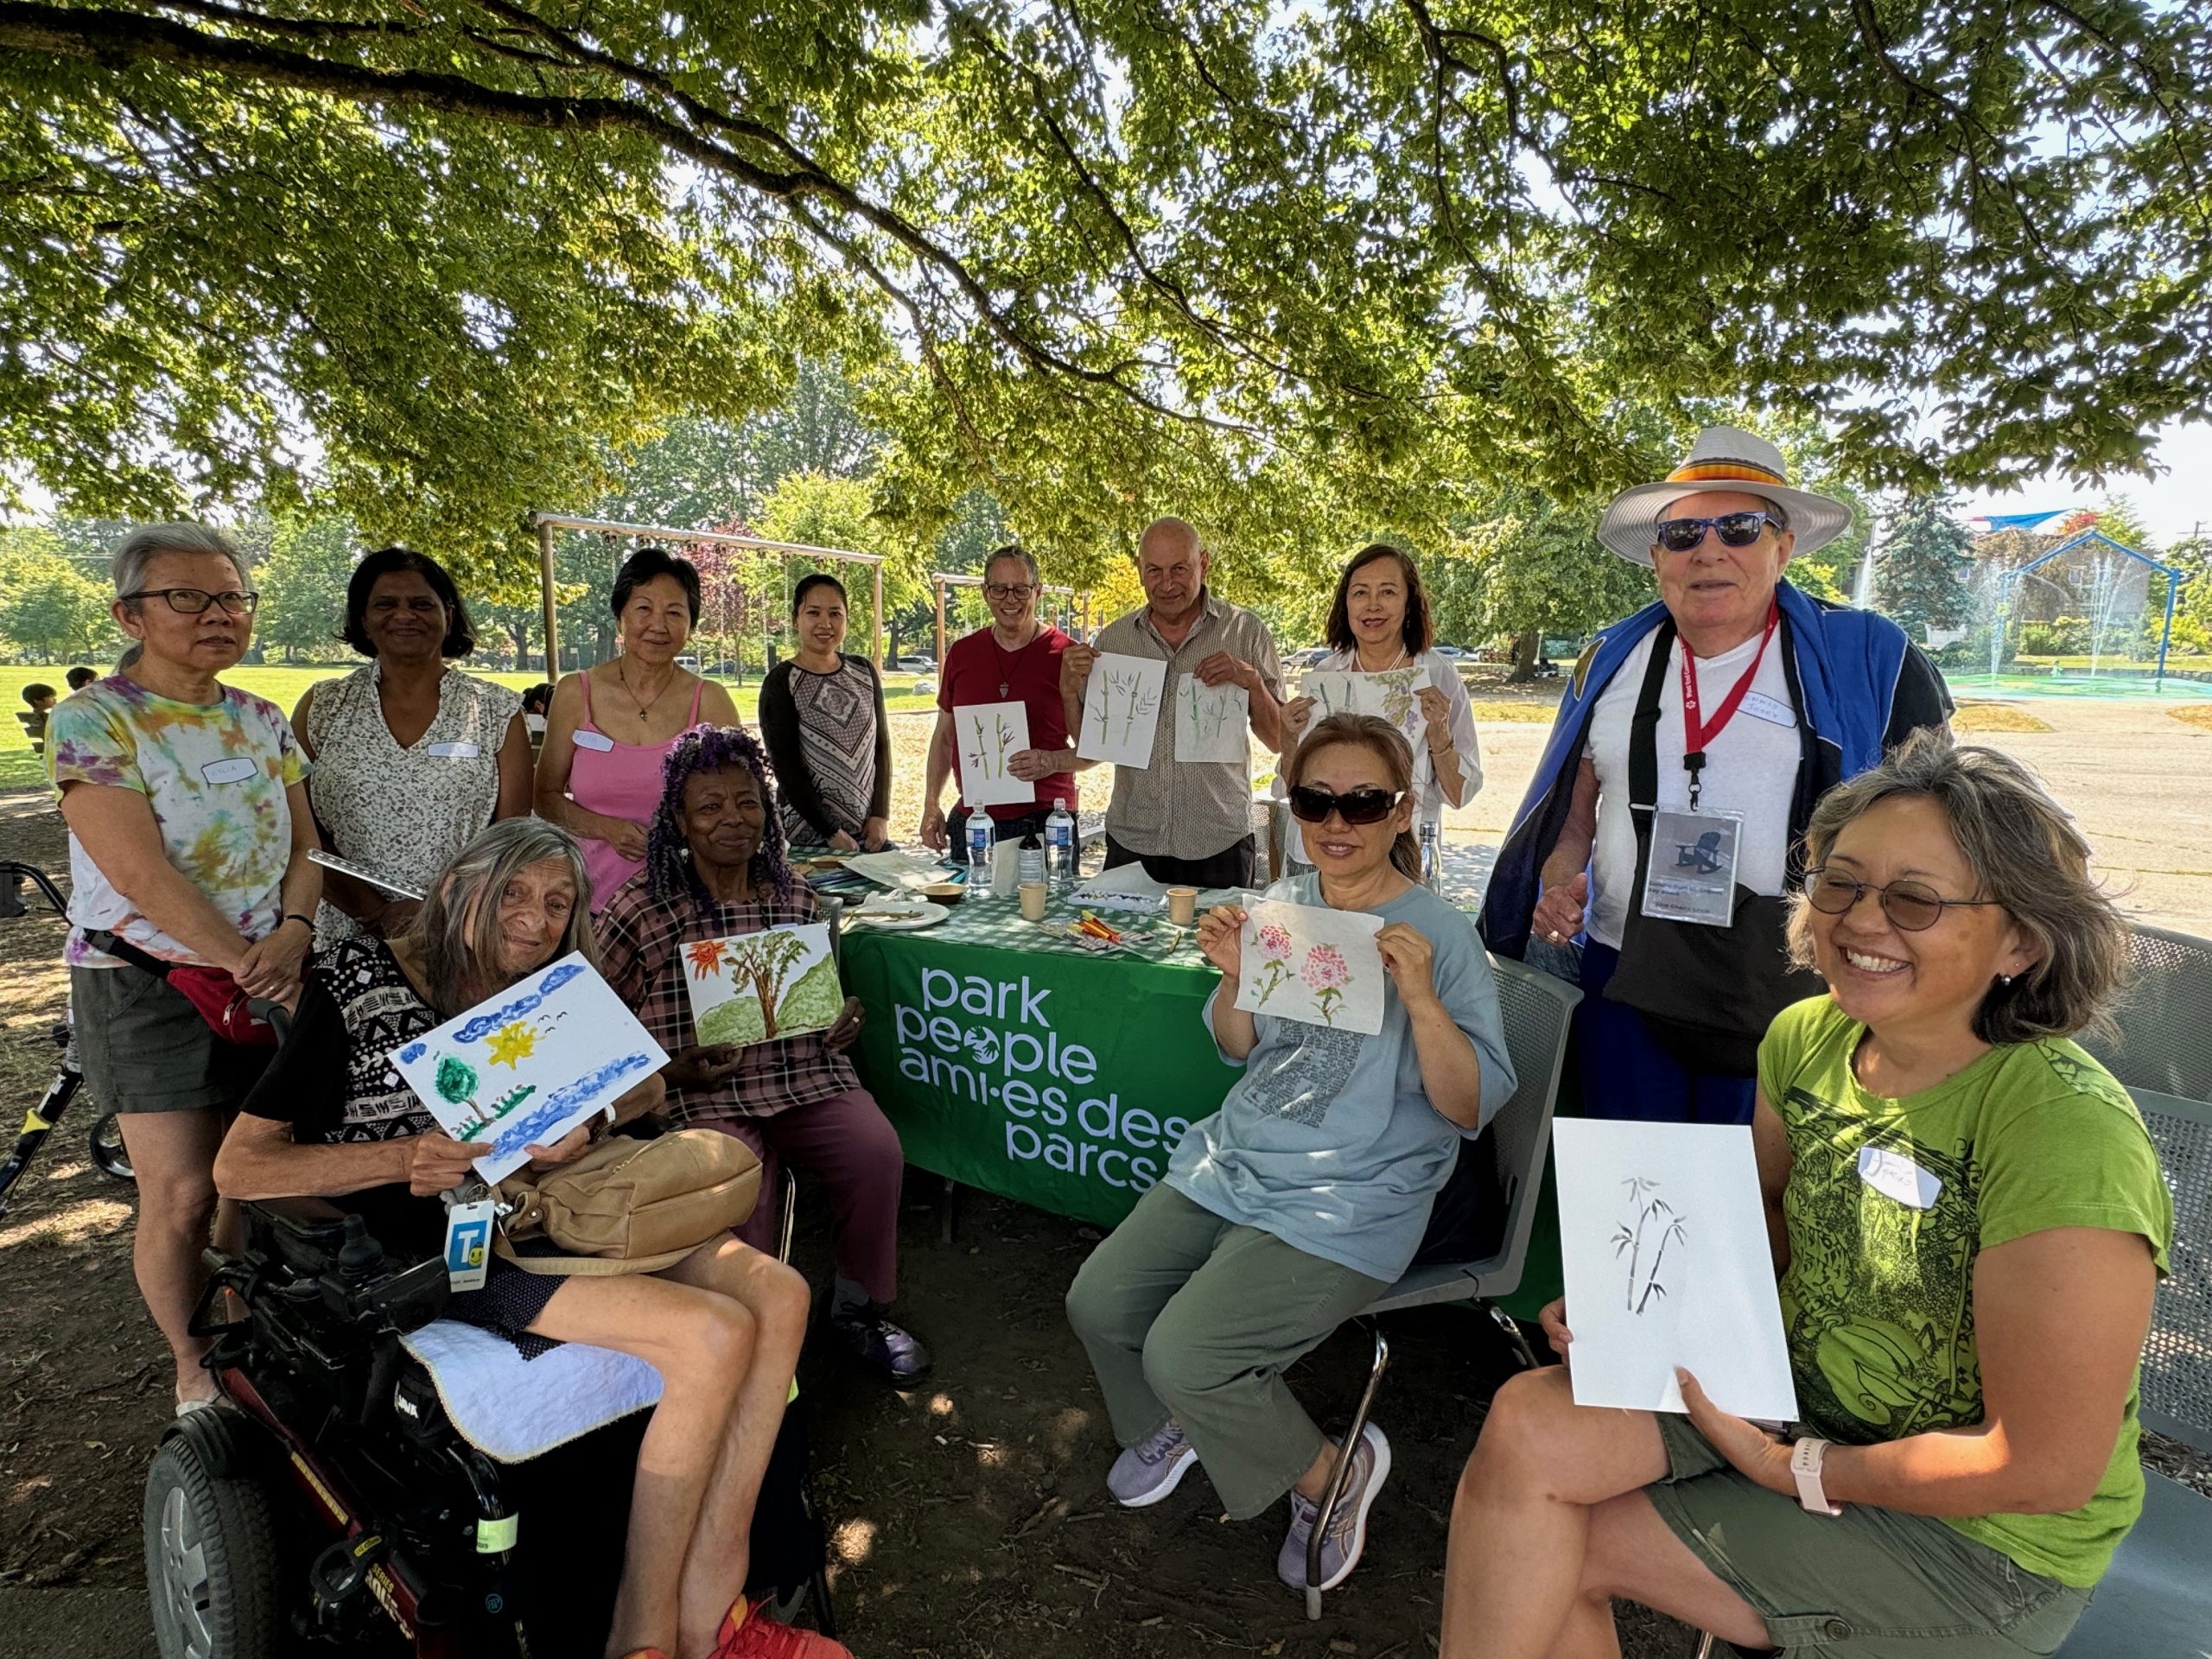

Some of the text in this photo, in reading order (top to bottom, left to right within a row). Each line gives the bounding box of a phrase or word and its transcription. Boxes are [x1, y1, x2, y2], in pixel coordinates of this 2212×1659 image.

[921, 968, 1052, 1028] park
[1077, 1094, 1190, 1154] des
[1006, 1121, 1158, 1193] parcs
[372, 1562, 394, 1594] SERIES
